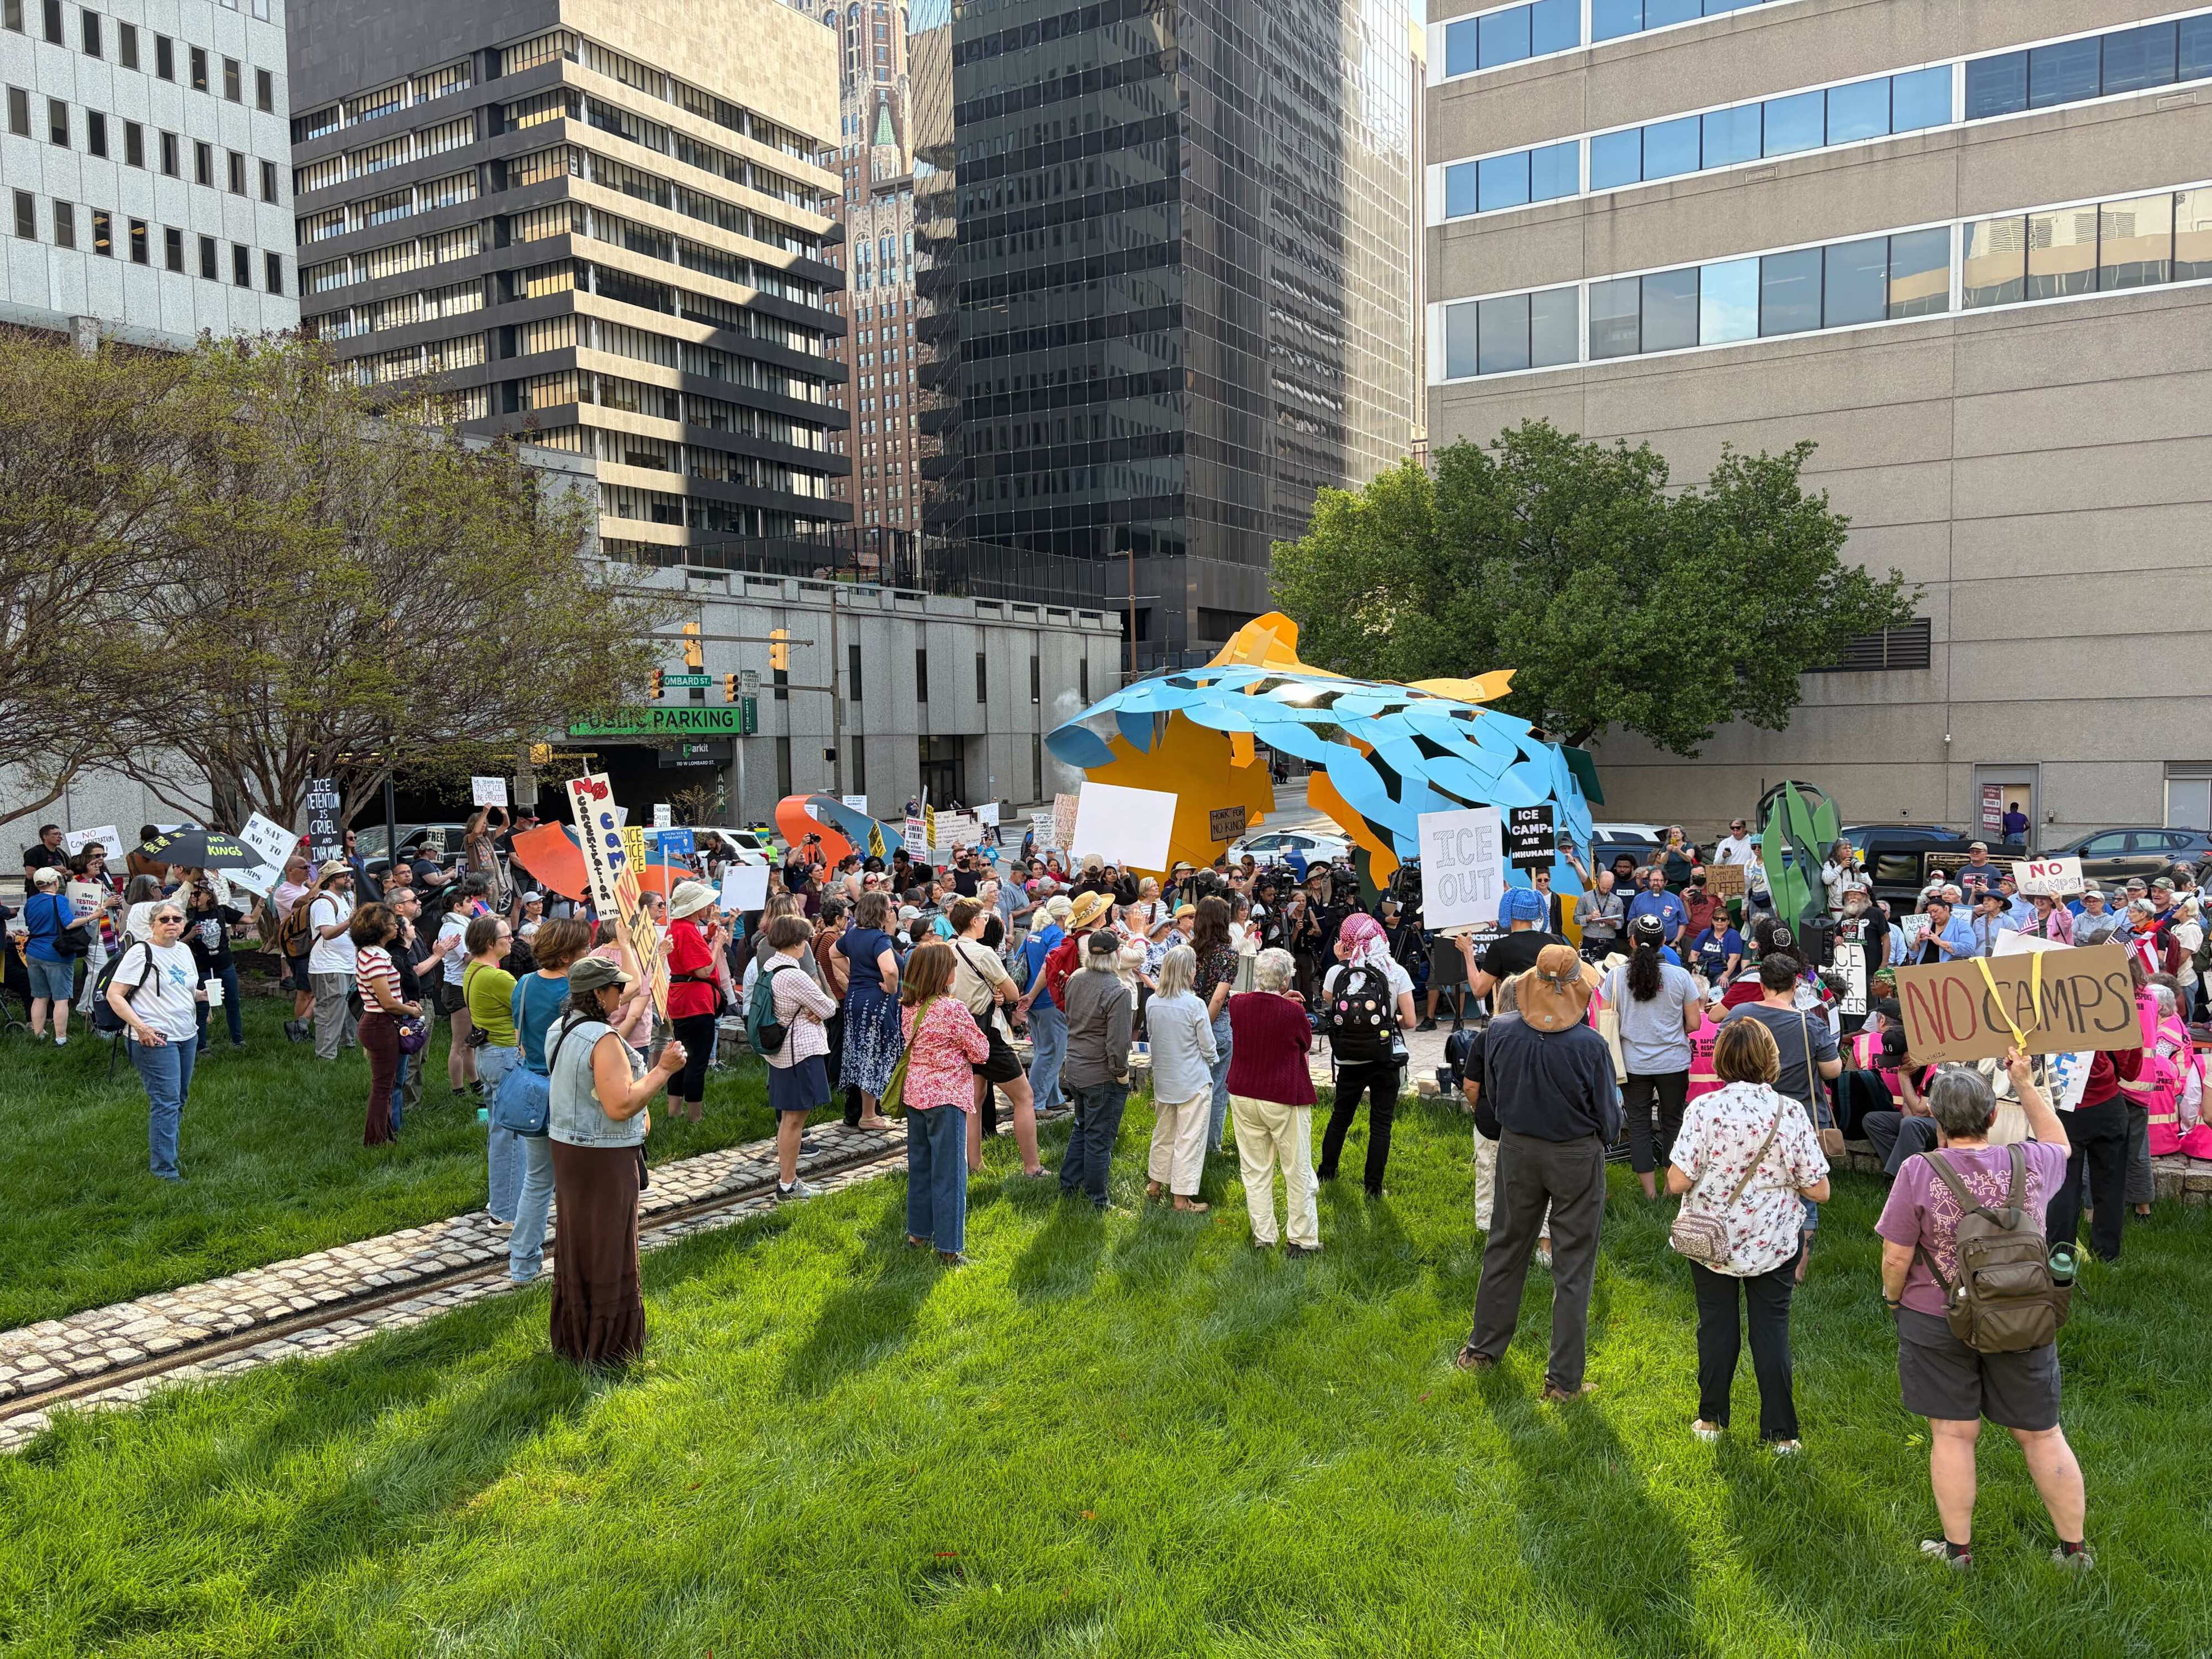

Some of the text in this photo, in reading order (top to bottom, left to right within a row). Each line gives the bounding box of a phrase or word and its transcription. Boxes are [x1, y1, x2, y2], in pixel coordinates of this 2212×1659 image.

[664, 677, 698, 686] OMBARD
[654, 710, 734, 727] PARKING
[313, 779, 330, 792] ICE
[307, 792, 339, 809] DETENTION
[319, 809, 327, 818] IS
[1212, 808, 1244, 820] HONK FOR
[1518, 809, 1539, 821] ICE
[310, 820, 338, 835] CRUEL
[1213, 819, 1245, 833] NO KINGS
[81, 830, 97, 839] NO
[264, 827, 283, 841] SAY
[427, 831, 445, 843] FREE
[207, 845, 243, 856] KINGS
[249, 833, 281, 856] NO TO
[1433, 826, 1492, 868] ICE
[312, 845, 343, 862] INHUMANE
[1512, 848, 1554, 859] INHUMANE
[2030, 863, 2062, 878] NO
[1438, 867, 1495, 906] OUT
[1708, 881, 1744, 895] COFFEE
[2025, 877, 2081, 893] CAMPS!
[618, 867, 637, 918] NO
[1906, 915, 1929, 924] NEVER
[1983, 972, 2130, 1033] CAMPS
[1906, 977, 1977, 1045] NO
